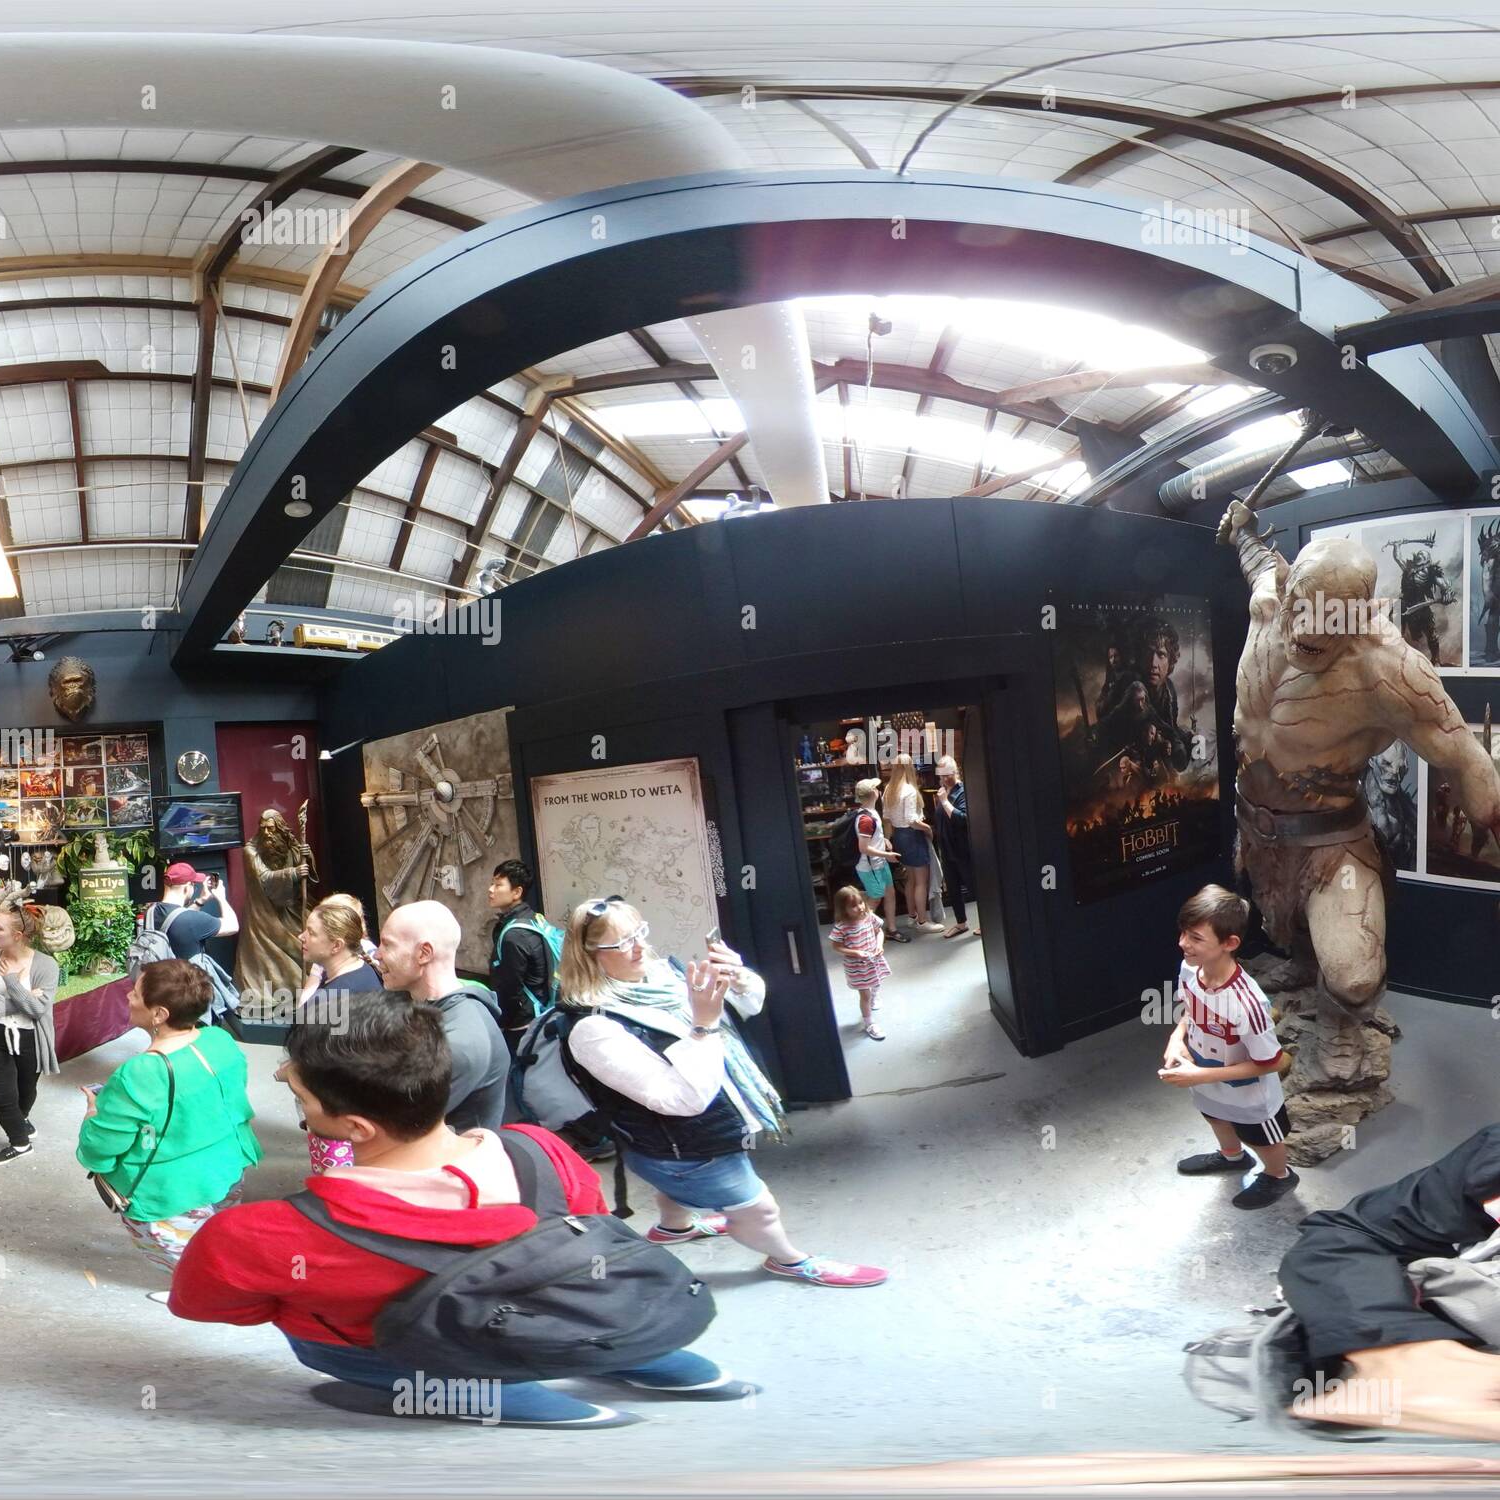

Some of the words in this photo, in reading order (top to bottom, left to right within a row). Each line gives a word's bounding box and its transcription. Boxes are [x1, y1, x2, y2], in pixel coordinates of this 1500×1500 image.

[544, 795, 569, 806] FROM
[572, 793, 588, 803] THE
[591, 789, 627, 801] WORLD
[630, 788, 646, 798] TO
[648, 784, 682, 796] WETA
[81, 878, 99, 888] Pal
[100, 877, 125, 889] Tiya
